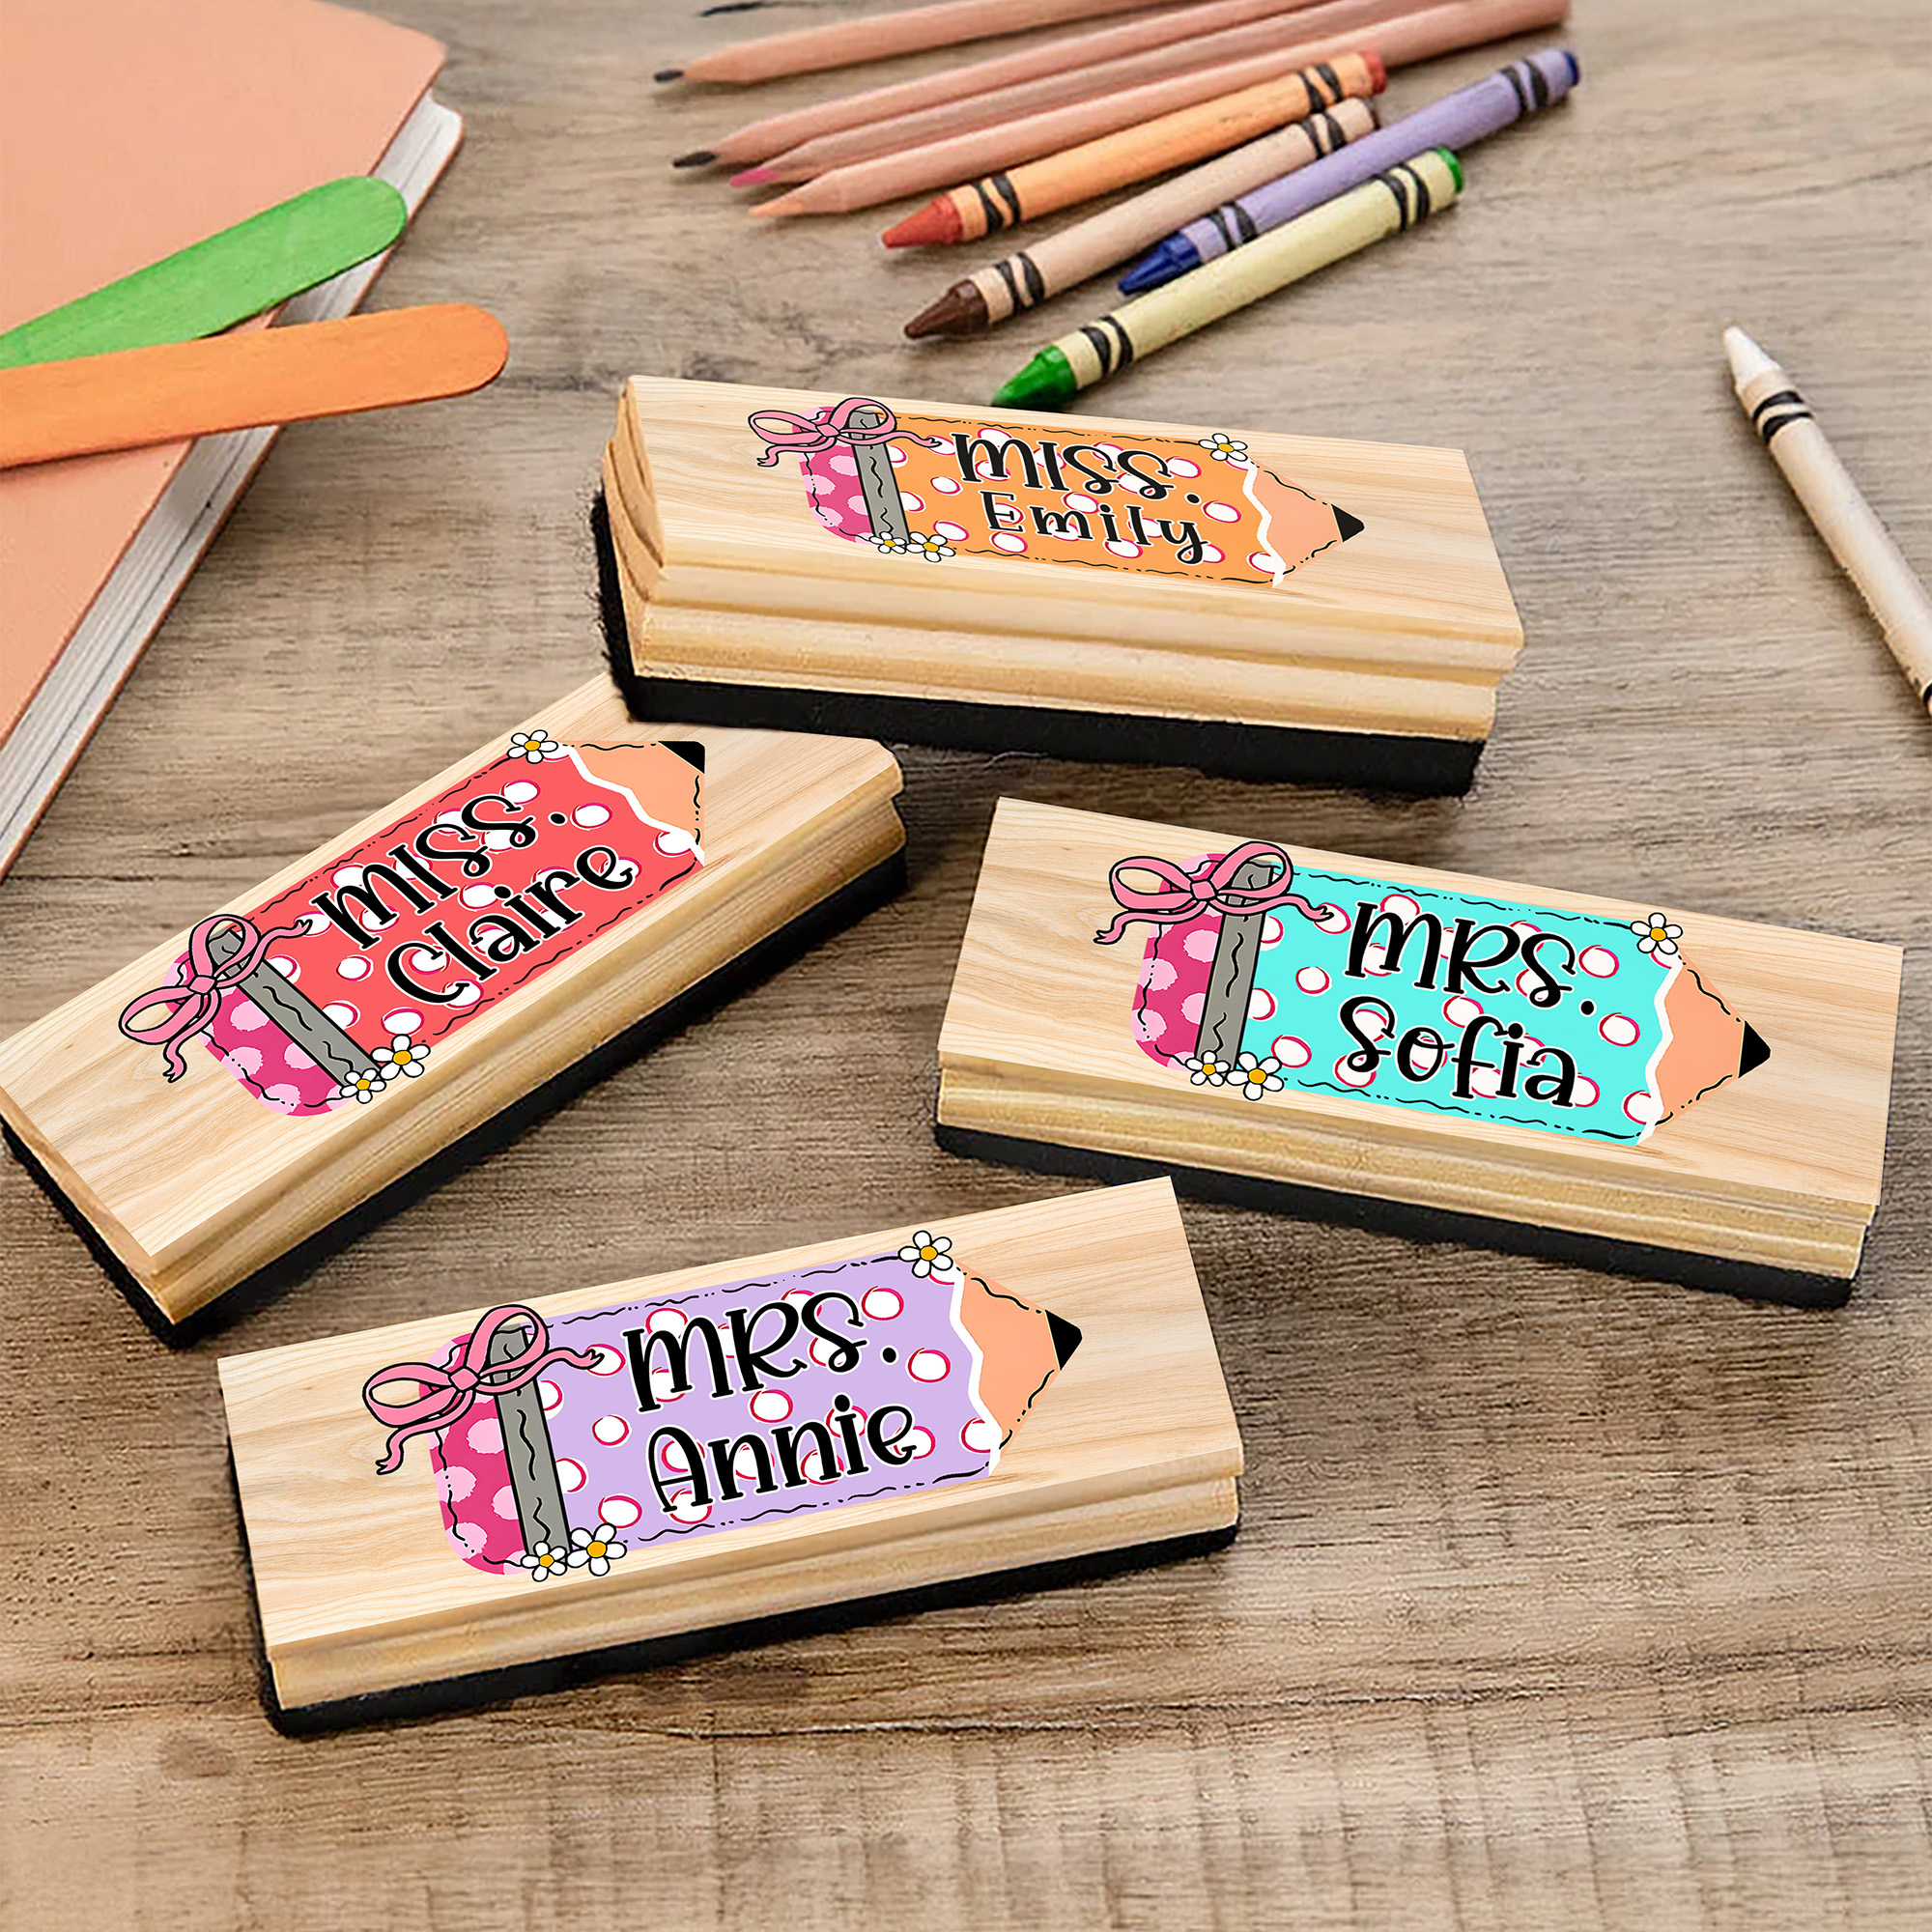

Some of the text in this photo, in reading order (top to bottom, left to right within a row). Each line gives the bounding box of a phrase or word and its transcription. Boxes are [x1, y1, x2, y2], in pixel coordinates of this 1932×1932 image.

[980, 491, 1212, 564] Emily
[387, 846, 634, 1004] Claire
[1339, 996, 1593, 1108] Sofia
[648, 1394, 917, 1513] Annie
